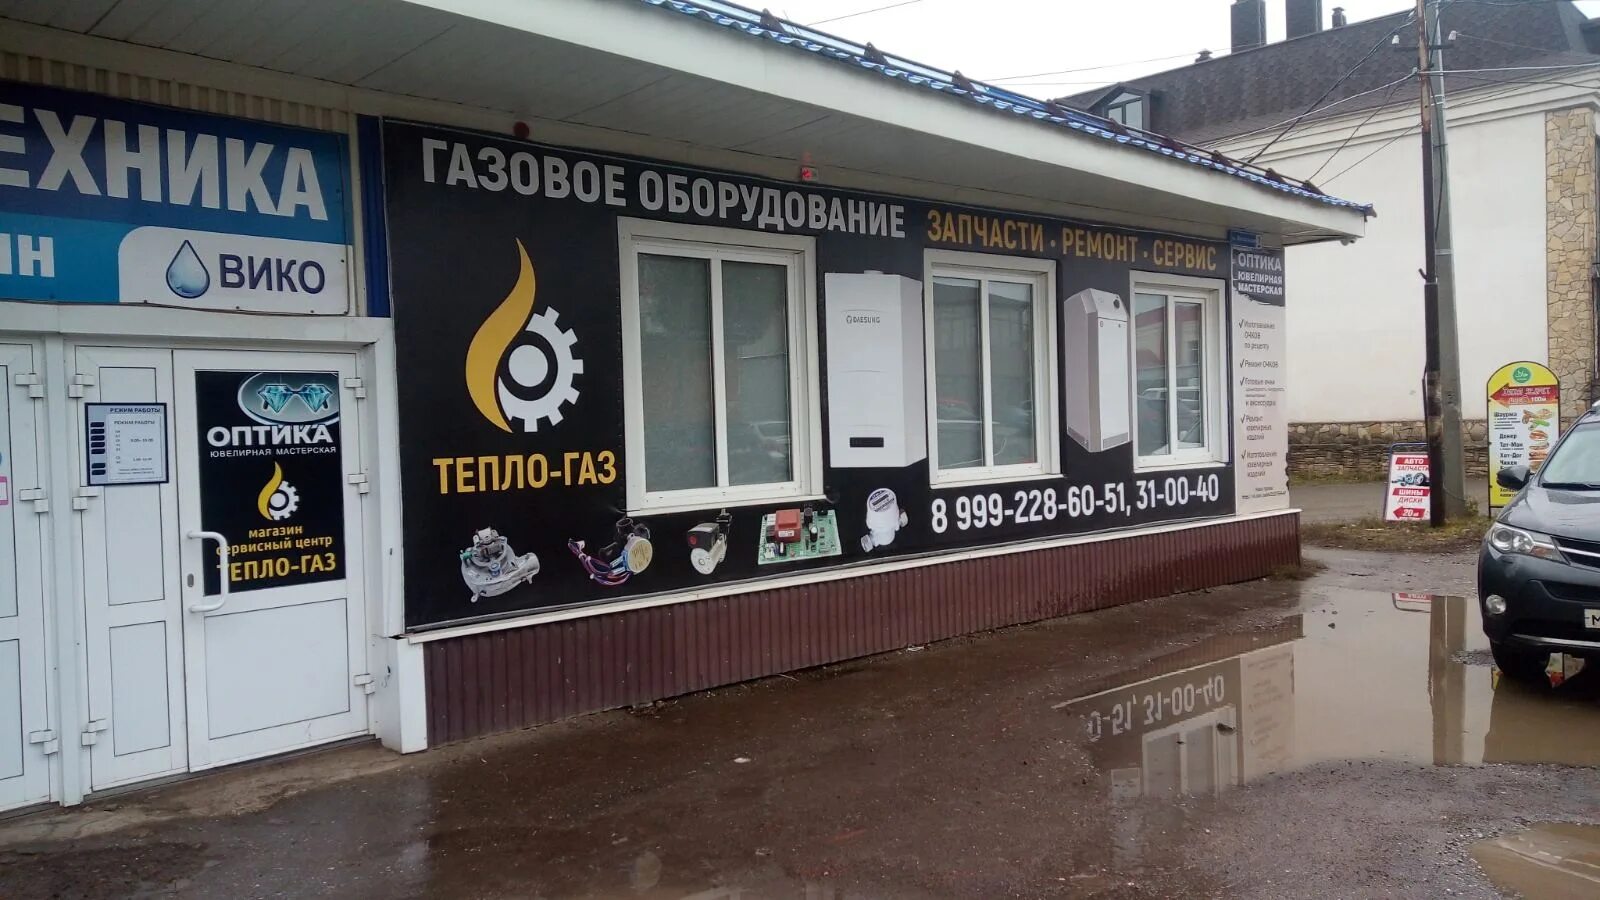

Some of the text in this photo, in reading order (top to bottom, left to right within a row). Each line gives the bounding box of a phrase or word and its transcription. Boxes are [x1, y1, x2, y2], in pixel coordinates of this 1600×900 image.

[422, 137, 906, 239] ГАЗОВОЕ ОБОРУДОВАНИЕ
[927, 209, 1217, 271] ЗАПЧАСТИ РЕМОНТ СЕРВИС
[1238, 252, 1282, 271] ОПТИКА
[219, 254, 325, 295] ВИКО
[1238, 271, 1283, 284] ЮВЕЛИРНАЯ
[1238, 283, 1283, 296] МАСТЕРСКАЯ
[207, 424, 334, 447] ОПТИКА
[210, 446, 337, 458] ЮВЕЛИРНАЯ МАСТЕРСКАЯ
[433, 450, 617, 494] ТЕПЛО-ГАЗ
[931, 499, 948, 534] 8
[956, 488, 1131, 530] 999-228-60-51,
[1136, 474, 1220, 510] 31-00-40
[1398, 496, 1423, 504] ДИСКИ
[248, 525, 304, 539] магазин
[295, 535, 333, 549] центр
